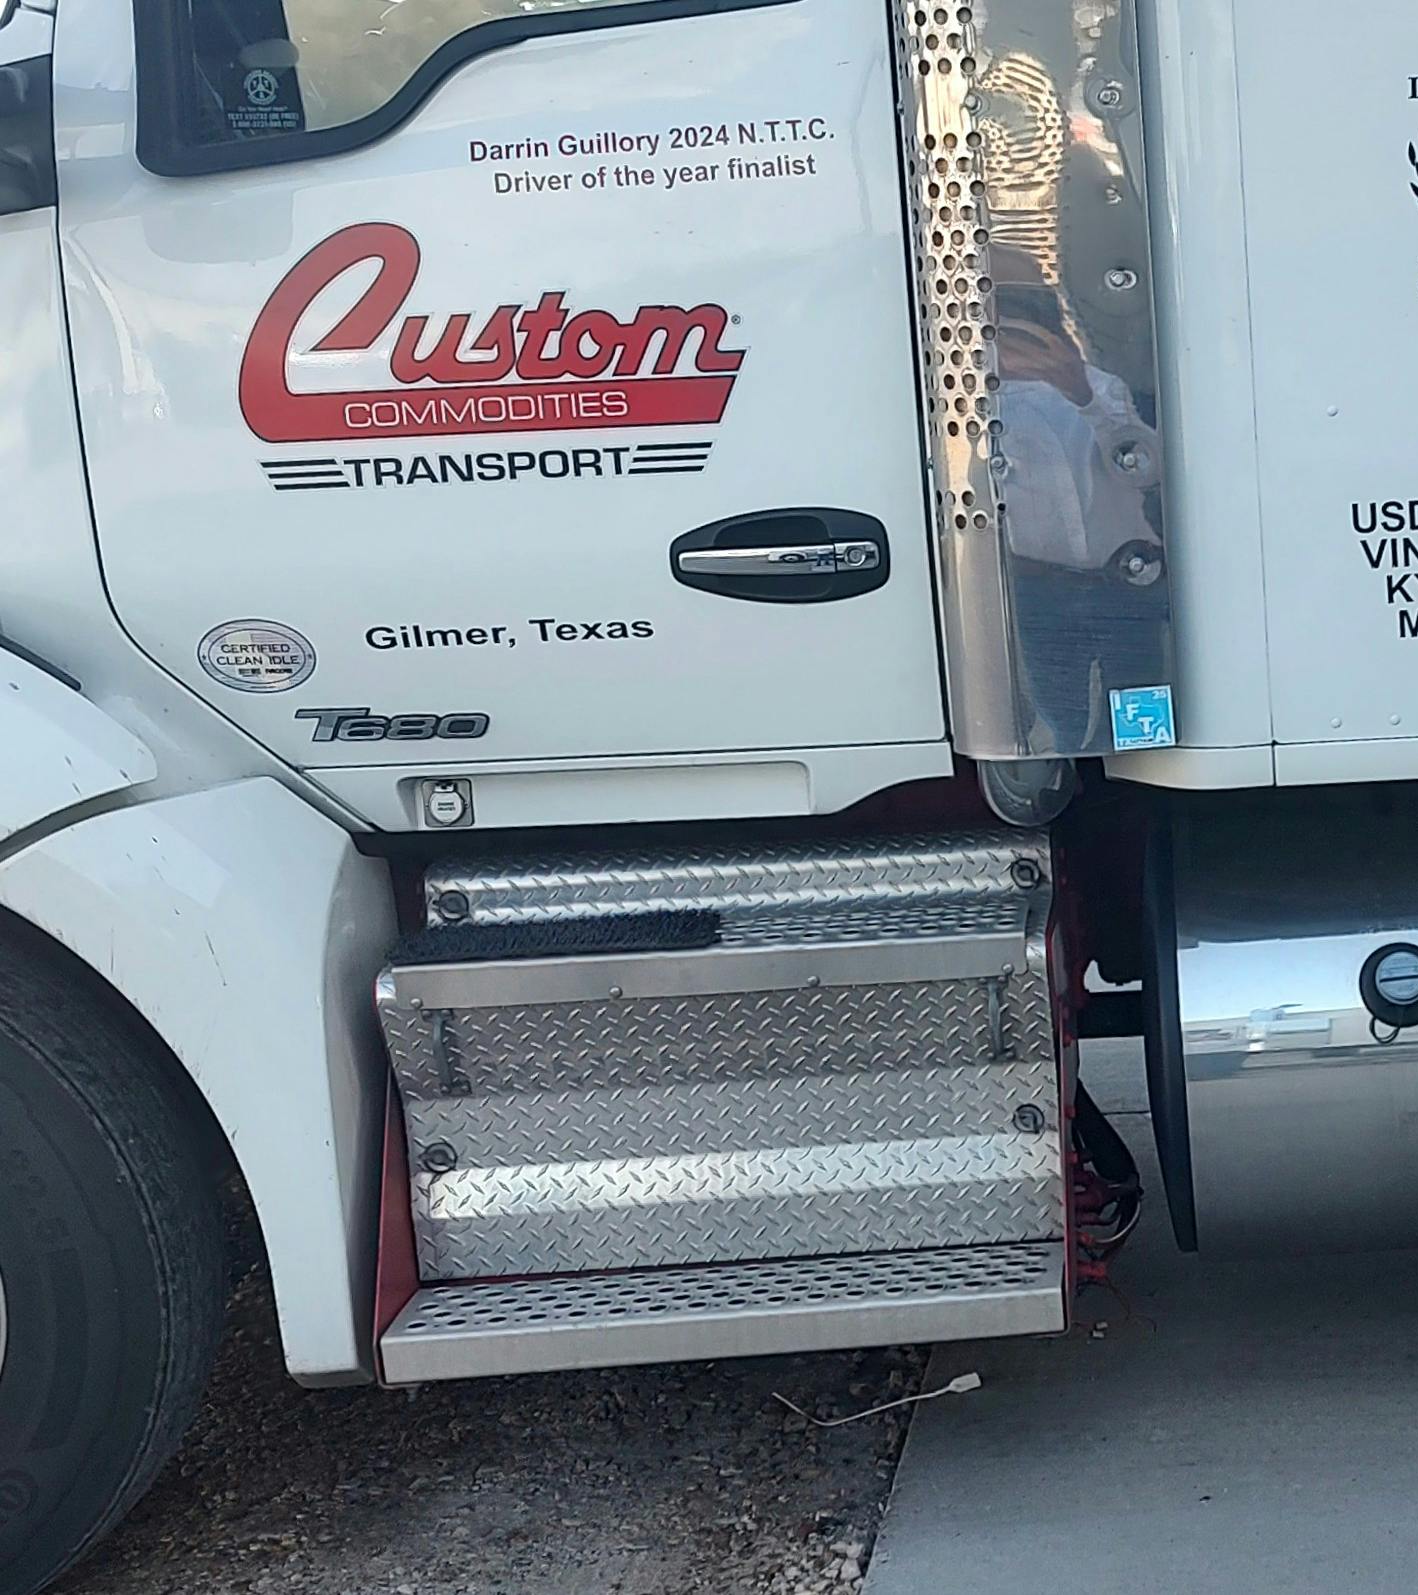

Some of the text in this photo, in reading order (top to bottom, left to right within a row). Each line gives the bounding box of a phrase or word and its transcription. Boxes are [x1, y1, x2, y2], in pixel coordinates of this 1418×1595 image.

[469, 118, 835, 162] Darrin Guillory 2024 N.T.T.C.
[494, 153, 817, 194] Driver of the year finalist
[239, 222, 746, 443] Custom
[344, 390, 628, 428] COMMODITIES
[342, 447, 629, 488] TRANSPORT
[221, 643, 291, 653] CERTIFIED
[365, 618, 654, 650] Gilmer, Texas
[216, 655, 300, 665] CLEAN IDLE
[295, 707, 490, 742] T680
